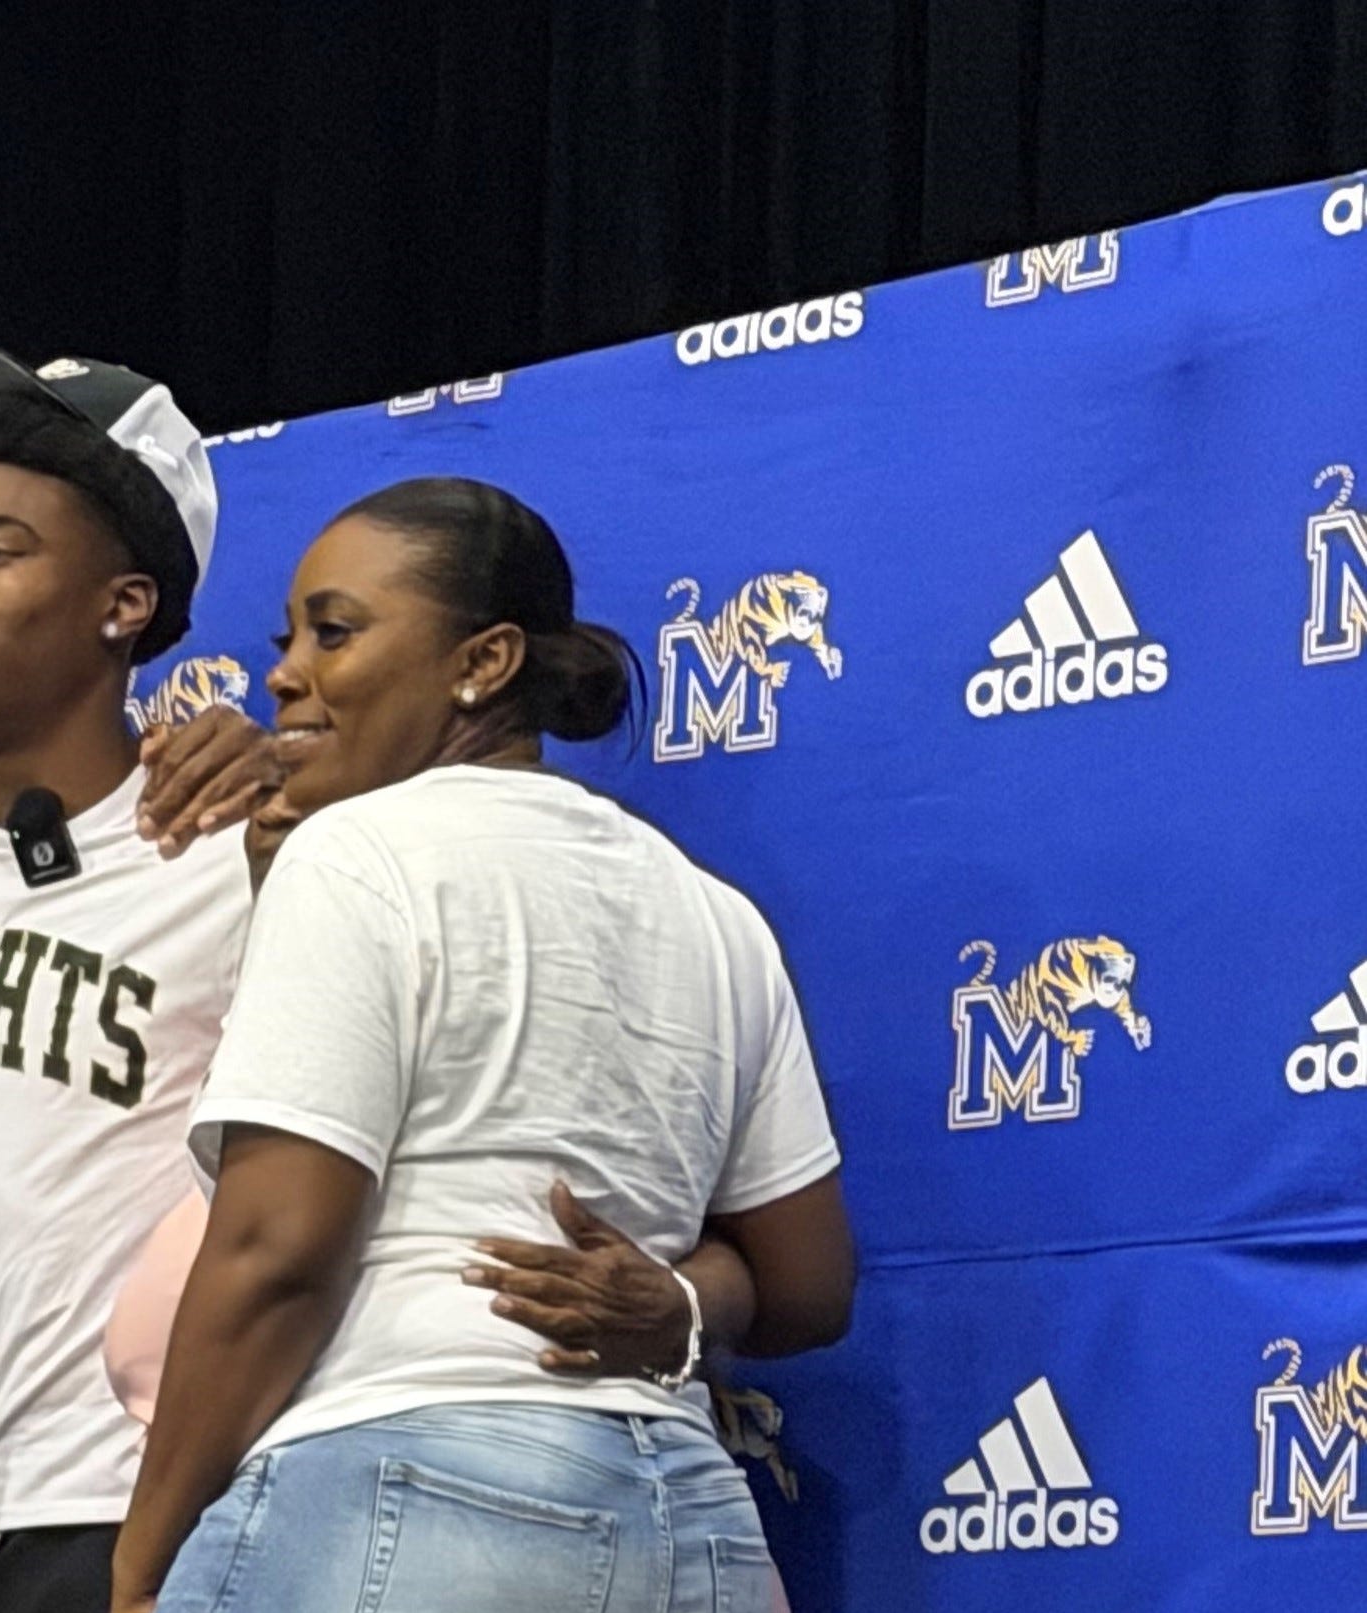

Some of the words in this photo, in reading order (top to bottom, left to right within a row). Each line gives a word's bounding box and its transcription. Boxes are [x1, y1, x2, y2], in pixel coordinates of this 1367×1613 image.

[1322, 183, 1367, 236] a
[654, 618, 777, 763] M
[966, 641, 1168, 718] adidas
[948, 984, 1080, 1131] M
[920, 1489, 1119, 1554] adidas
